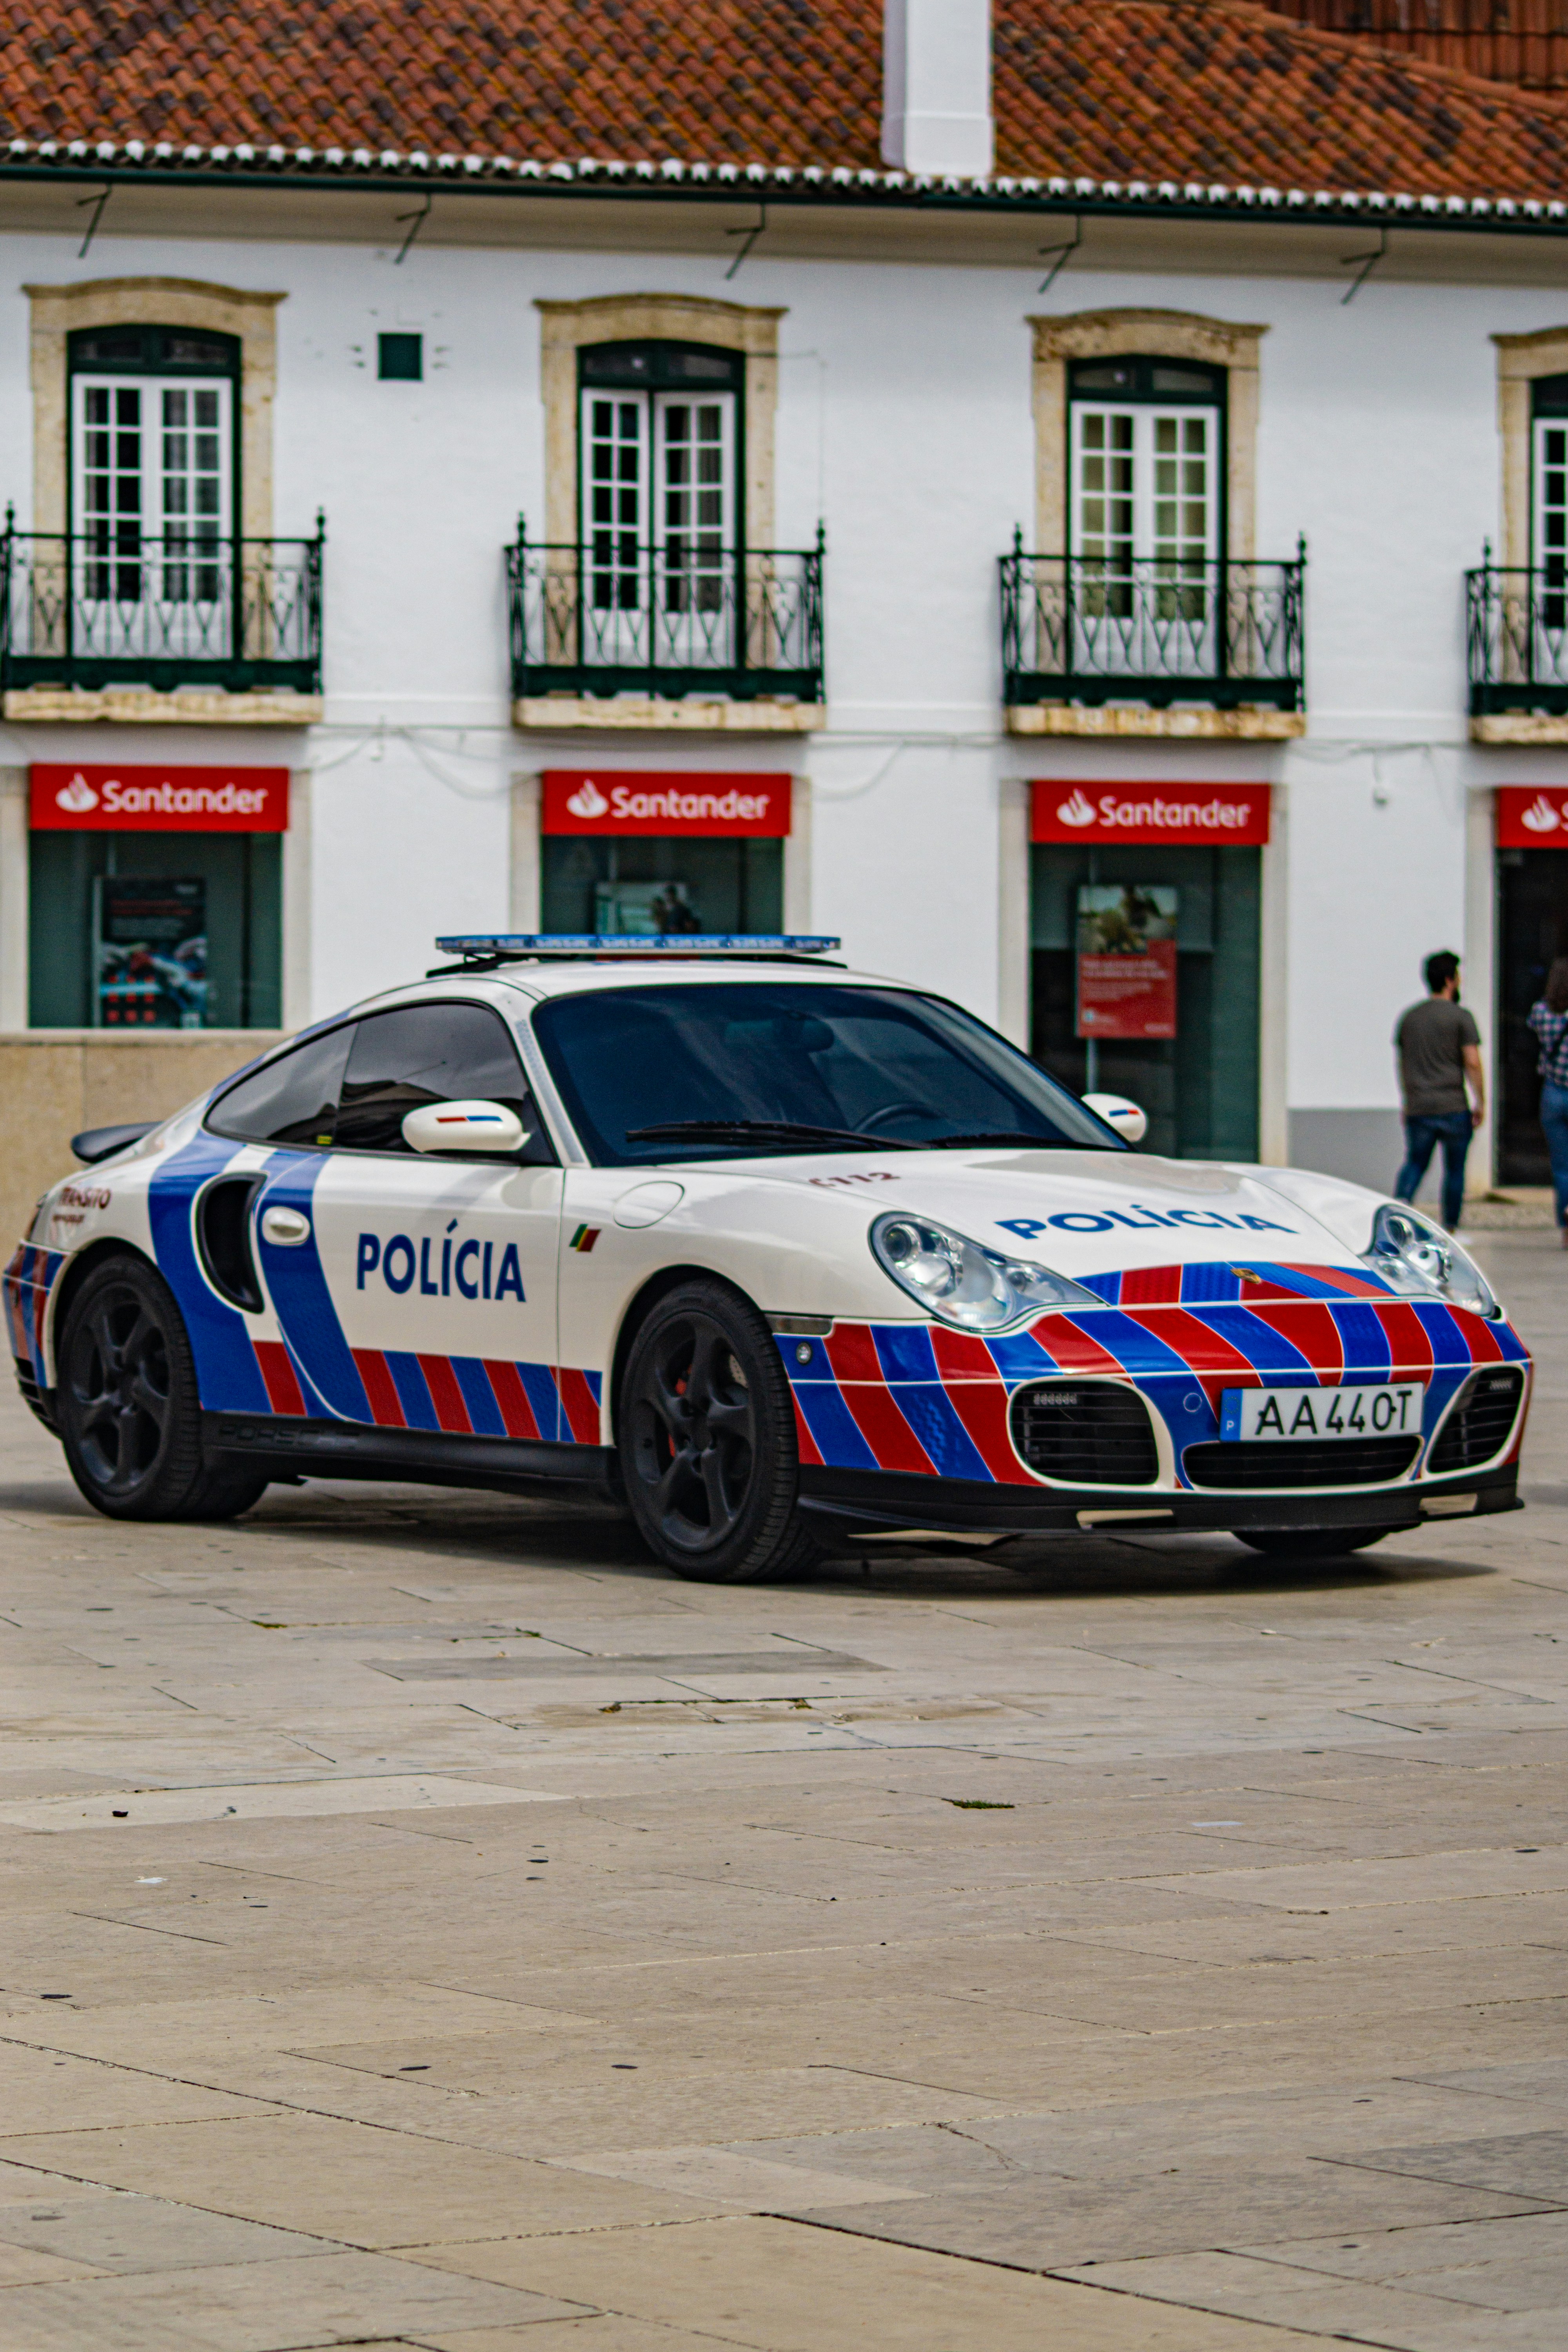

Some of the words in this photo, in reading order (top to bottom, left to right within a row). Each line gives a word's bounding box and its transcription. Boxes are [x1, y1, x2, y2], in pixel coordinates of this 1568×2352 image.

[102, 780, 268, 814] Santander
[610, 786, 770, 820] Santander
[1099, 796, 1250, 828] Santander
[993, 1204, 1300, 1240] POLÍCIA
[357, 1218, 526, 1303] POLÍCIA
[1227, 1420, 1234, 1431] P
